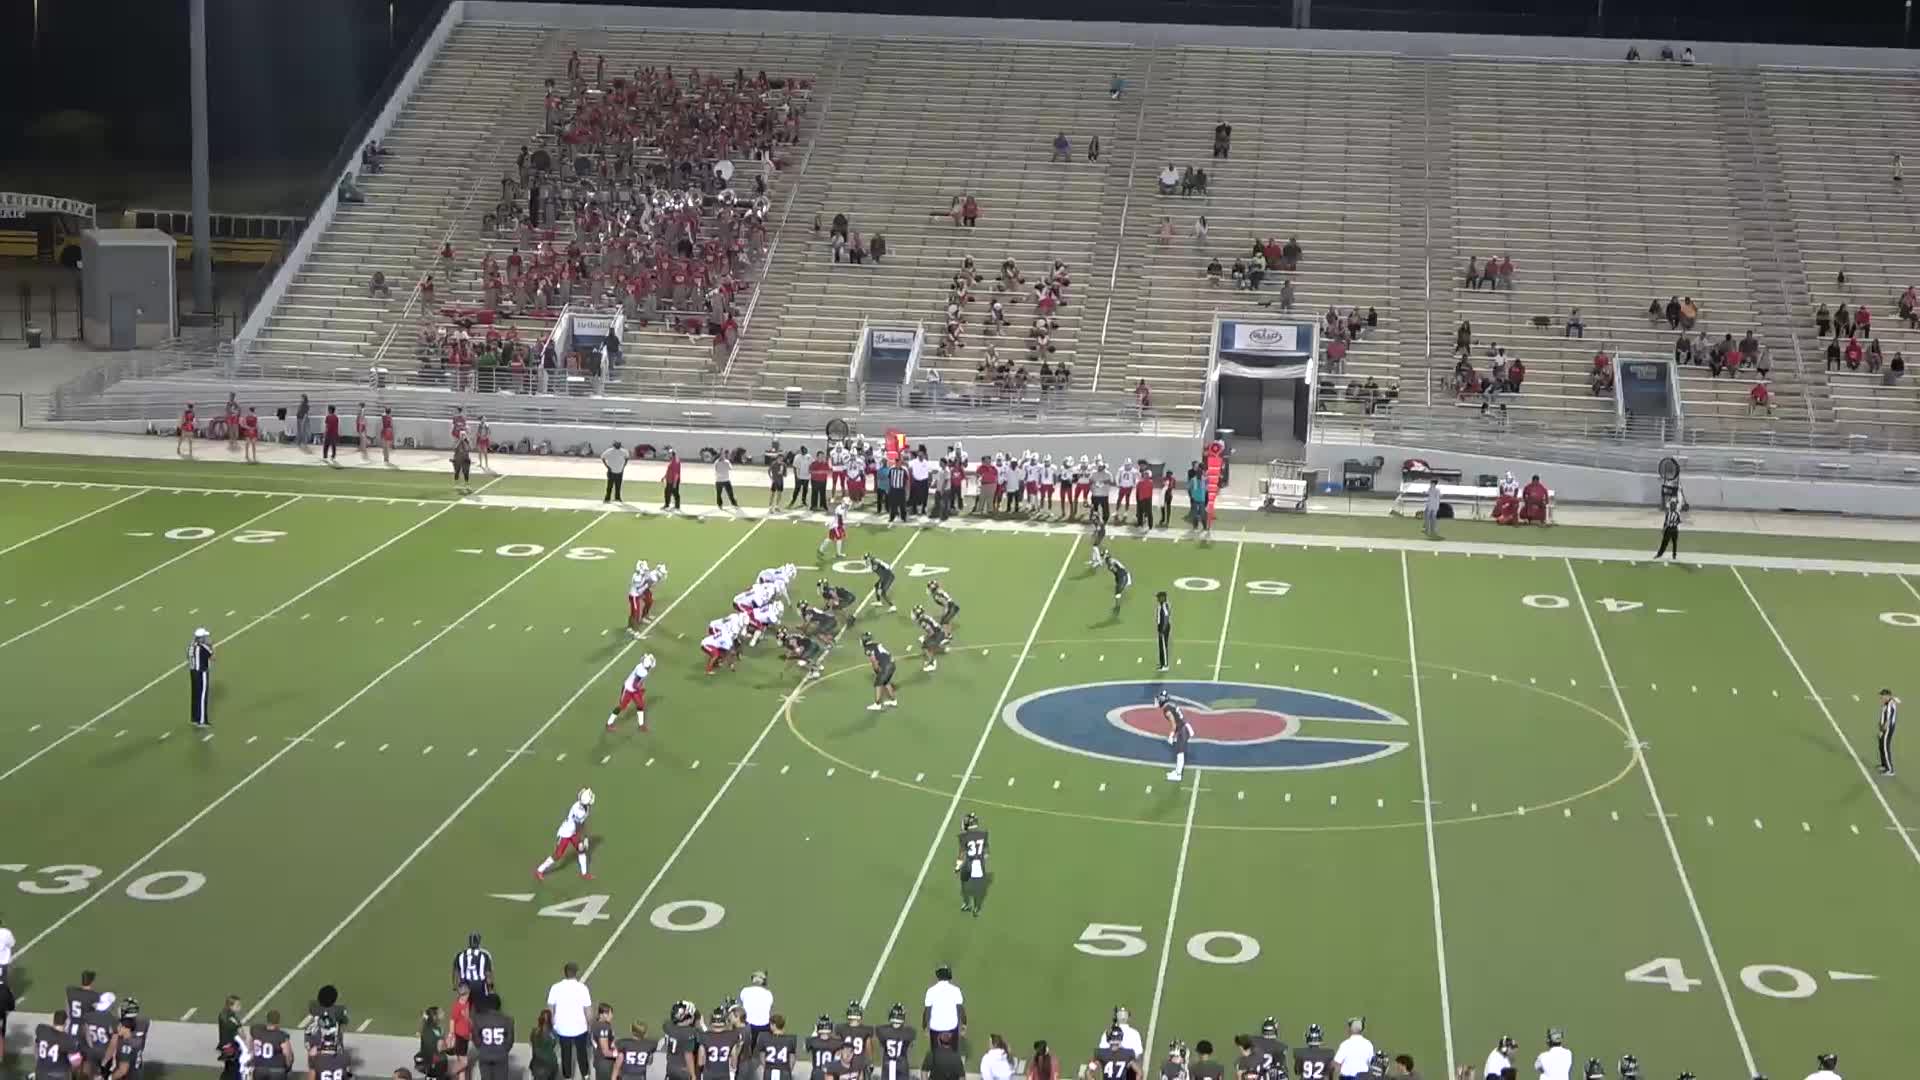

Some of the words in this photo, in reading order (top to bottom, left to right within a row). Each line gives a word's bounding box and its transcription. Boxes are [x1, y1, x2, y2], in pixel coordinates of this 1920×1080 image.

[967, 839, 984, 857] 37
[72, 1001, 82, 1018] 5
[481, 1027, 505, 1045] 95
[38, 1040, 59, 1063] 64
[254, 1040, 274, 1059] 60
[708, 1046, 729, 1062] 33
[766, 1046, 788, 1063] 24
[886, 1039, 903, 1057] 51
[1103, 1061, 1126, 1078] 47
[1303, 1061, 1325, 1079] 92
